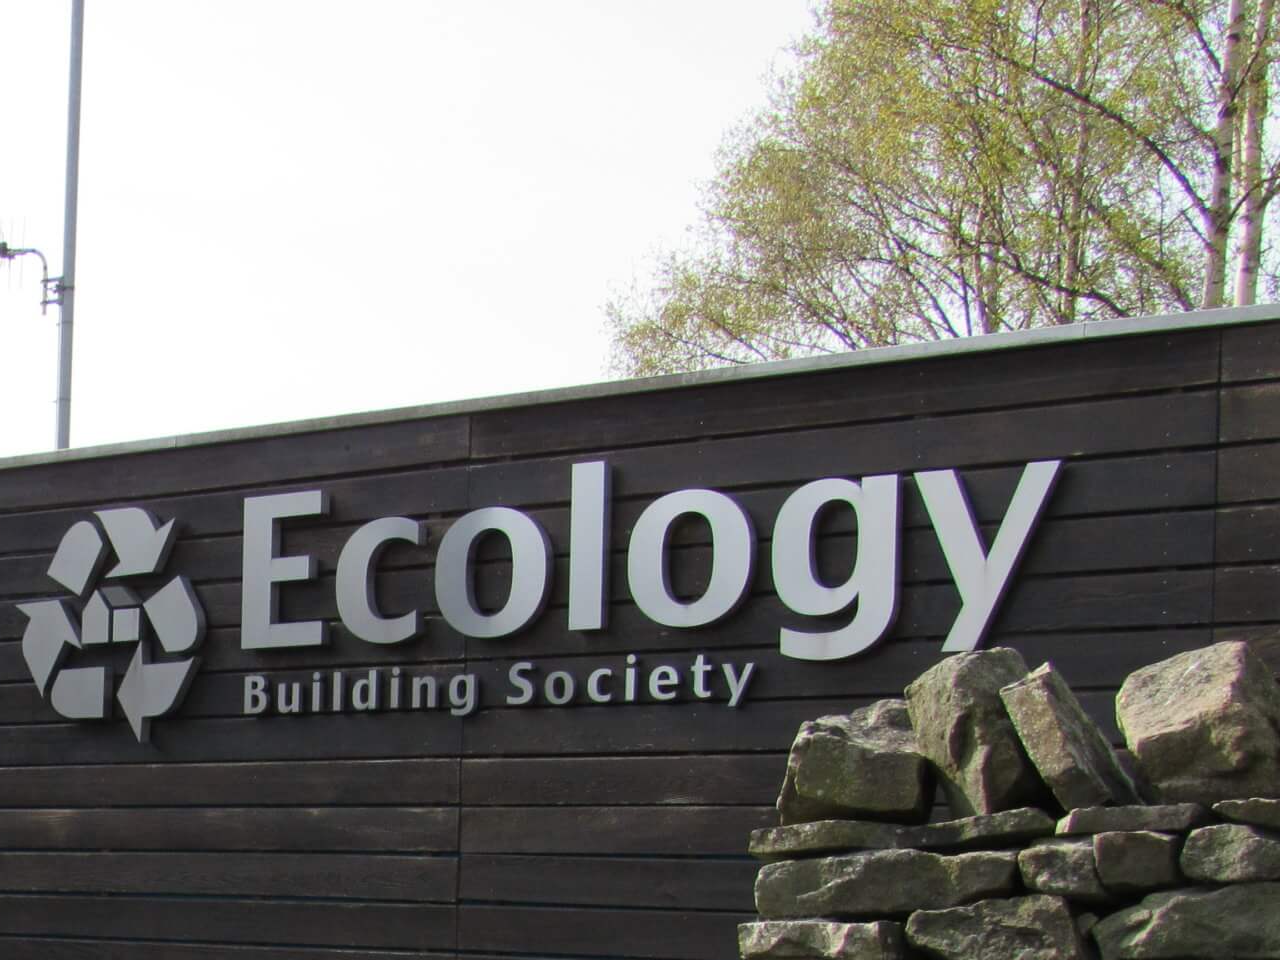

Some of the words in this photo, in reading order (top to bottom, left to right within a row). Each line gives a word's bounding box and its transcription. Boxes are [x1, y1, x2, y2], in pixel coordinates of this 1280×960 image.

[240, 460, 1063, 661] Ecology
[242, 667, 477, 717] Building
[507, 653, 756, 707] Society
